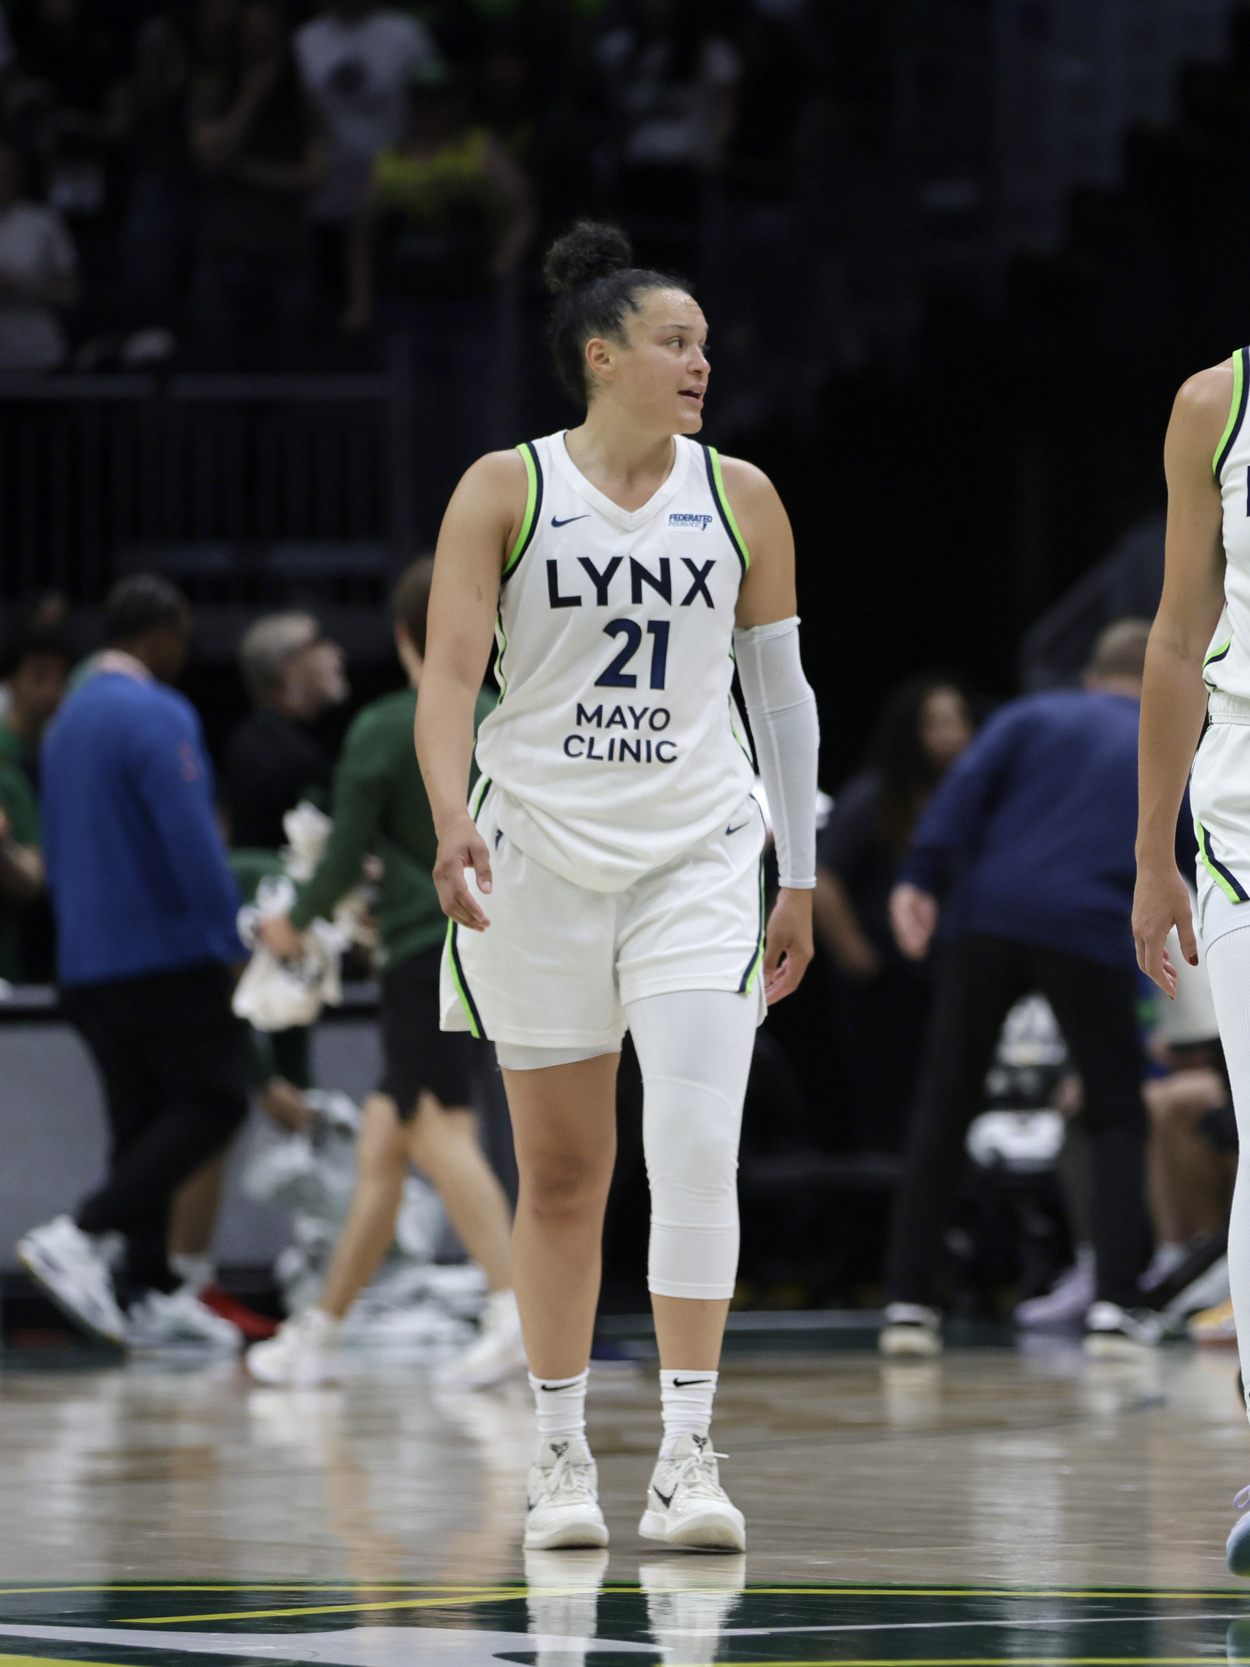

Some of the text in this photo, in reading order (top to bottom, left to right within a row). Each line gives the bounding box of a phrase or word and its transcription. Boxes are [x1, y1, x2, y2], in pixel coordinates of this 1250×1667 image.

[669, 513, 713, 526] FEDERATED
[546, 556, 717, 610] LYNX
[594, 618, 670, 690] 21
[576, 702, 671, 732] MAYO
[563, 734, 678, 764] CLINIC
